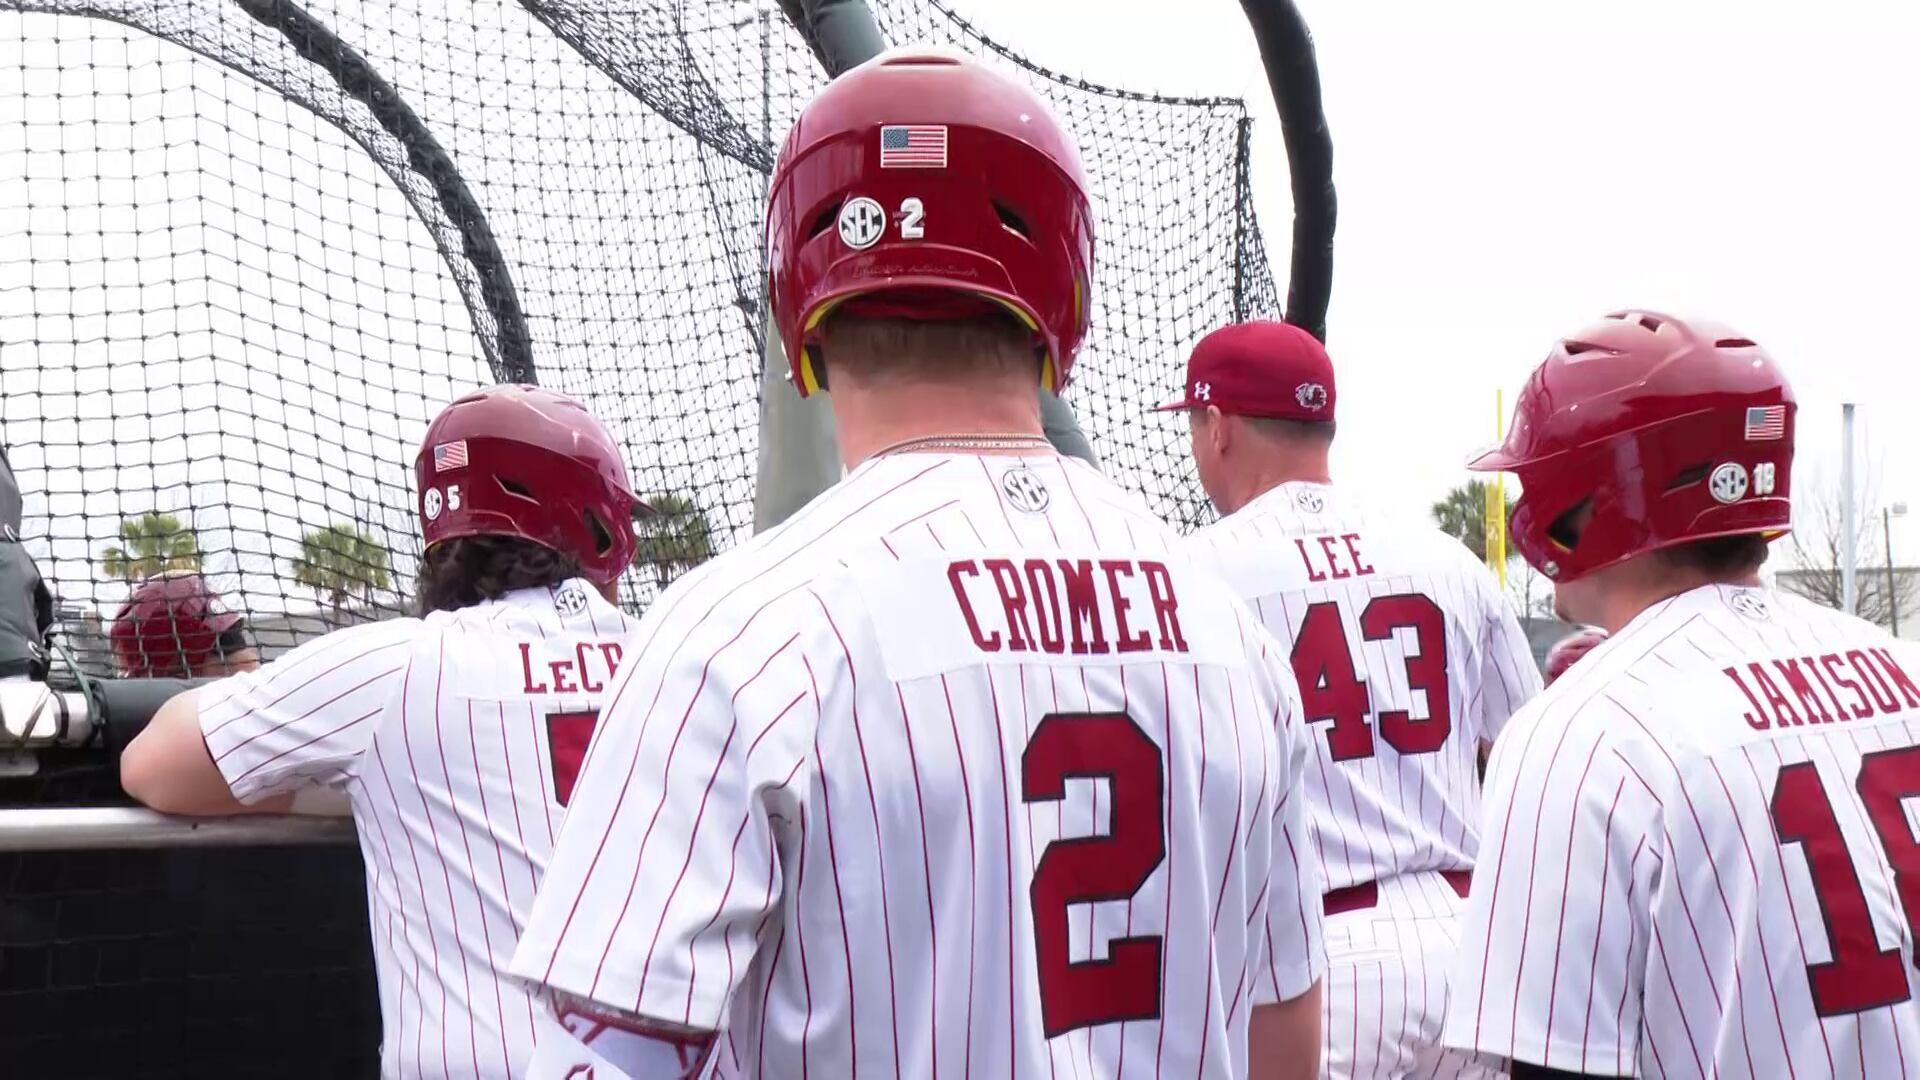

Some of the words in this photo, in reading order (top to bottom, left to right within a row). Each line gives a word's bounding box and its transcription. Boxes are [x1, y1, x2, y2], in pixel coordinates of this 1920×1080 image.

[841, 200, 883, 245] SEC
[900, 197, 924, 239] 2
[447, 485, 461, 511] 5
[1003, 470, 1049, 511] SEC
[1711, 465, 1746, 502] SEC
[1294, 533, 1375, 582] LEE
[555, 588, 587, 615] SEC
[947, 559, 1189, 654] CROMER
[1289, 593, 1451, 762] 43
[1722, 648, 1920, 731] JAMISON
[1021, 711, 1166, 1040] 2
